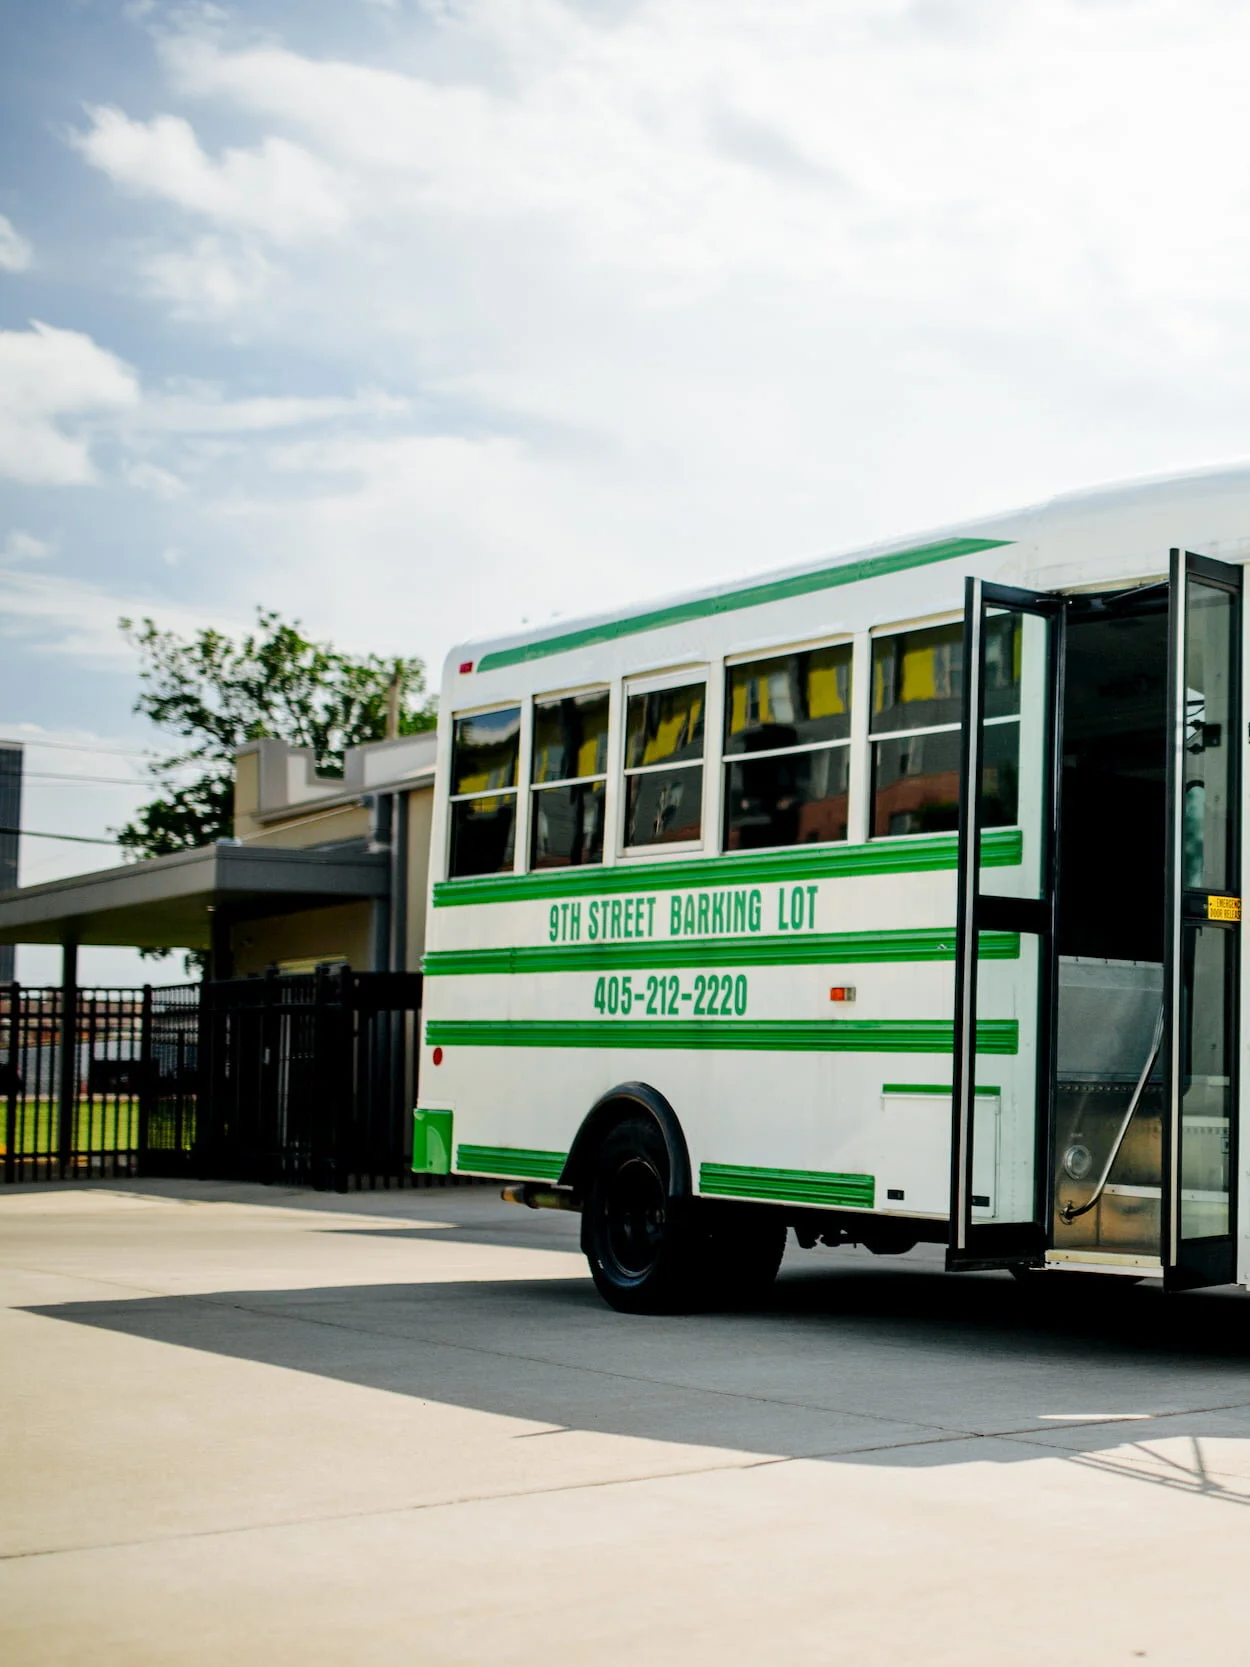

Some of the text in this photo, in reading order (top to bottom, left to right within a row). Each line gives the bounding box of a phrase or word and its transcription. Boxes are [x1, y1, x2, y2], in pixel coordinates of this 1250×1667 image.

[549, 885, 819, 942] 9TH STREET BARKING LOT
[593, 974, 748, 1017] 405-212-2220
